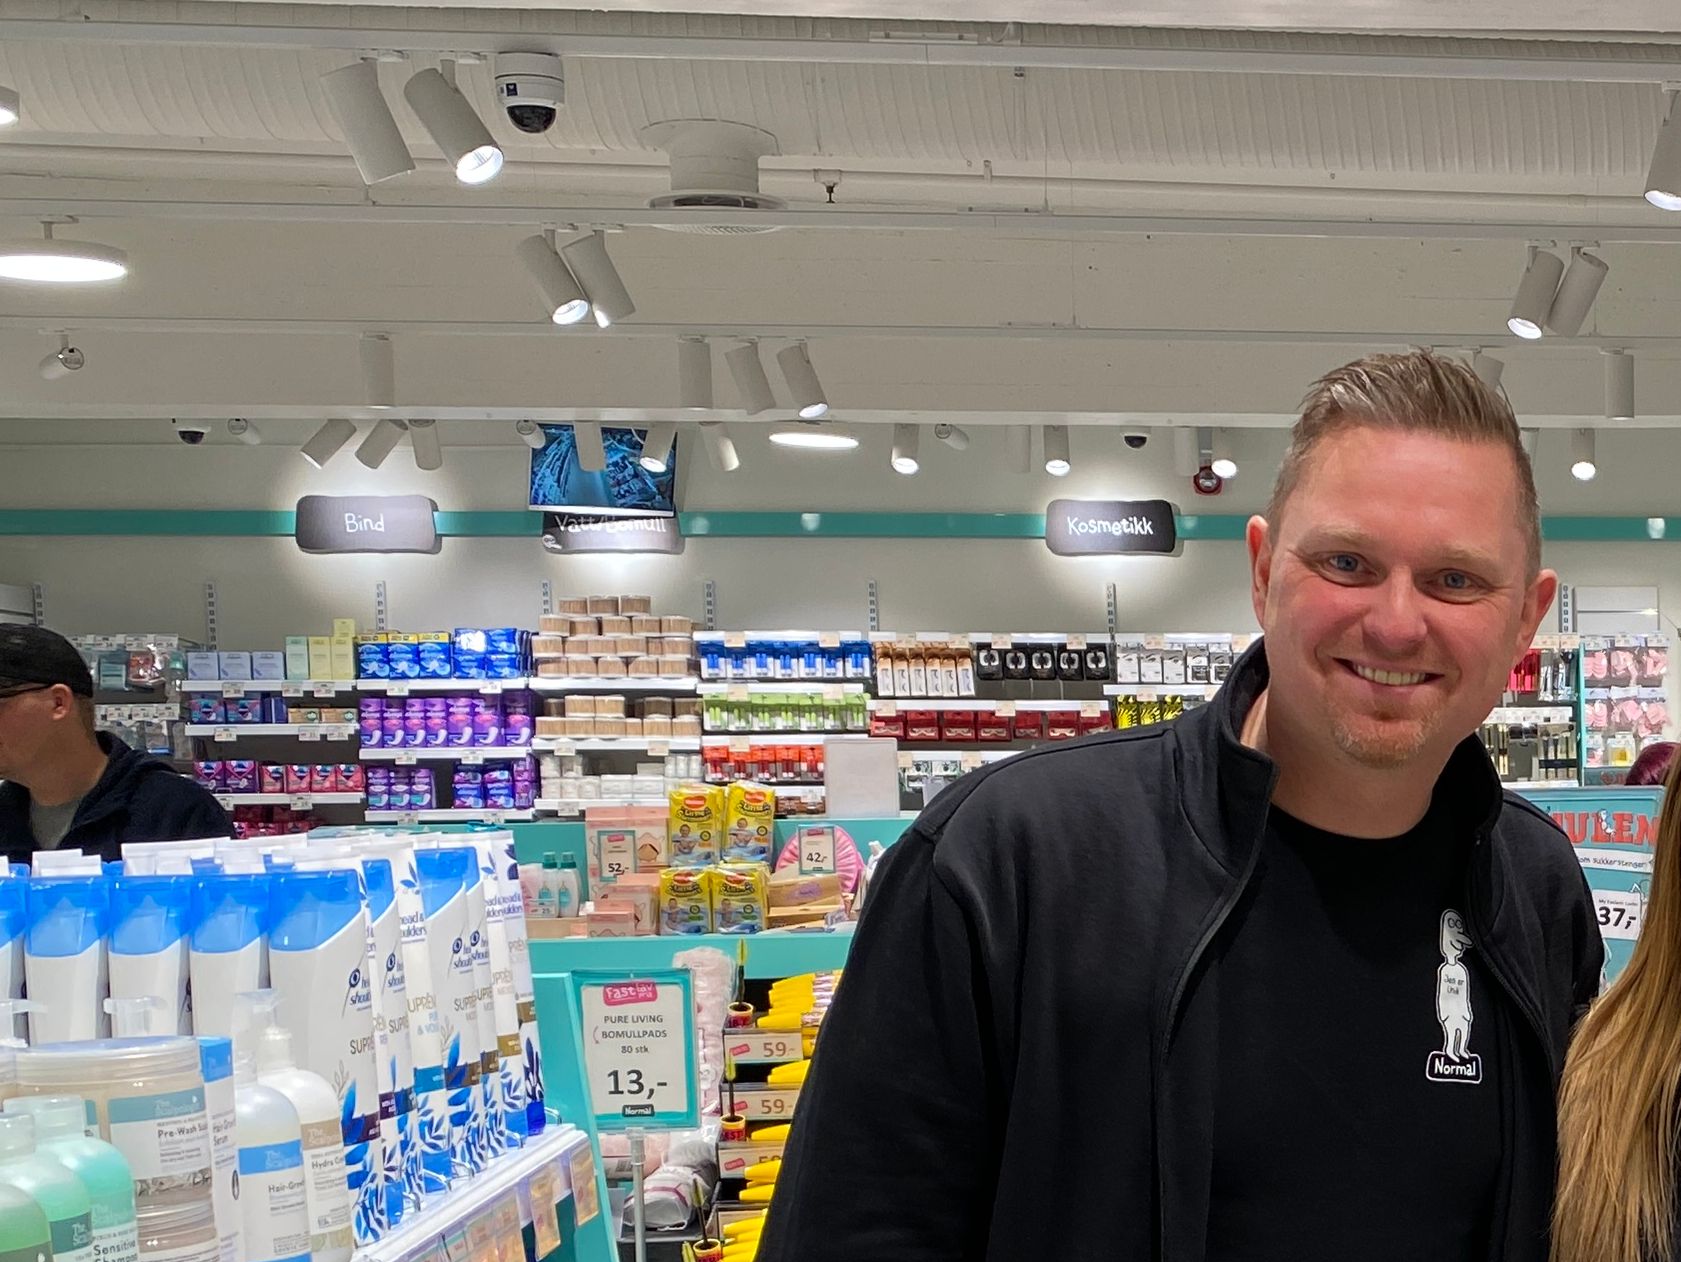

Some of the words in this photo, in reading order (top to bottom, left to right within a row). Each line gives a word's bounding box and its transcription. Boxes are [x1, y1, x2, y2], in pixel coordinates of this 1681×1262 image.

[345, 513, 385, 533] Bind
[1067, 516, 1153, 536] Kosmetikk
[606, 985, 636, 1000] Fast
[604, 1015, 628, 1024] PURE
[631, 1014, 664, 1023] LIVING
[601, 1029, 667, 1040] BOMULLPADS
[1434, 1057, 1476, 1077] Normal
[607, 1069, 667, 1099] 13,-
[625, 1106, 651, 1115] Normal
